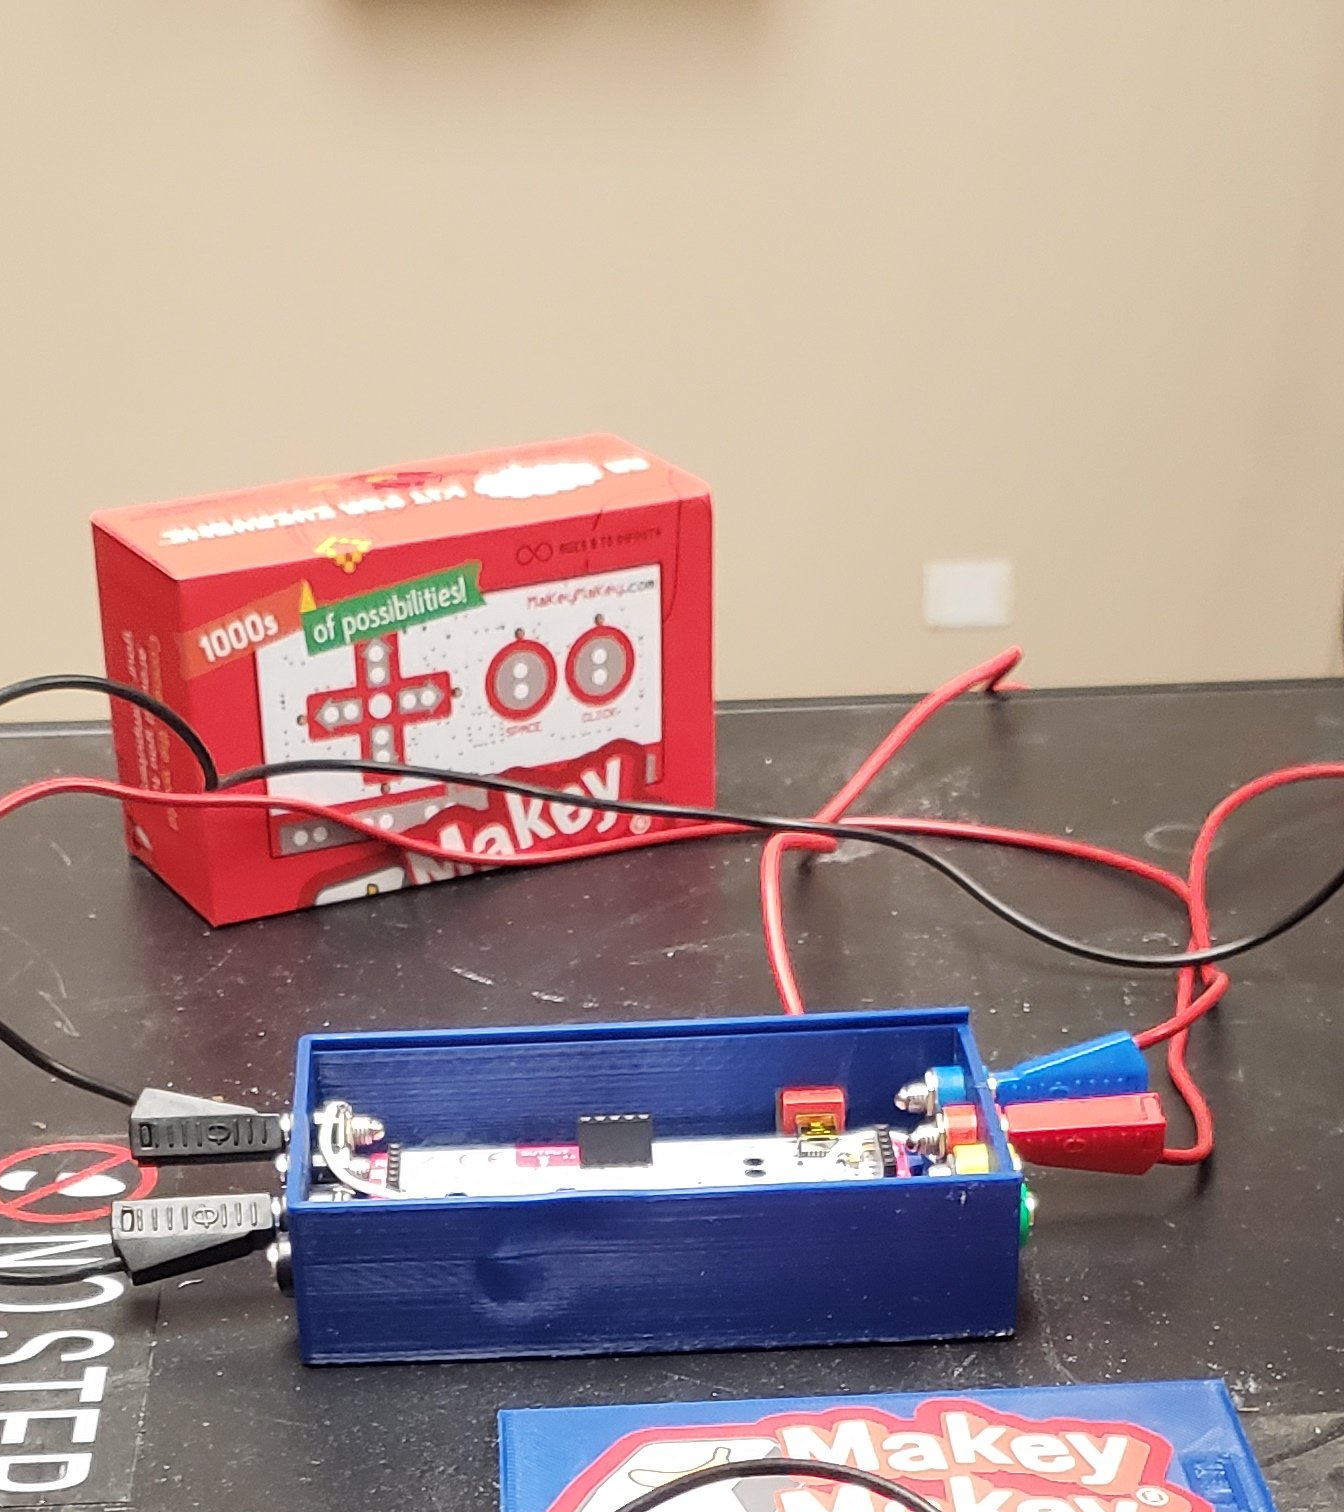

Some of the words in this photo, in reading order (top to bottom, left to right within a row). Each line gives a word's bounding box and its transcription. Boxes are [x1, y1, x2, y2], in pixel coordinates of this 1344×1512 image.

[199, 610, 279, 663] 1000s
[312, 612, 336, 644] of
[341, 576, 468, 645] possibilities!
[408, 756, 622, 885] Makey
[781, 1411, 1129, 1486] Makey
